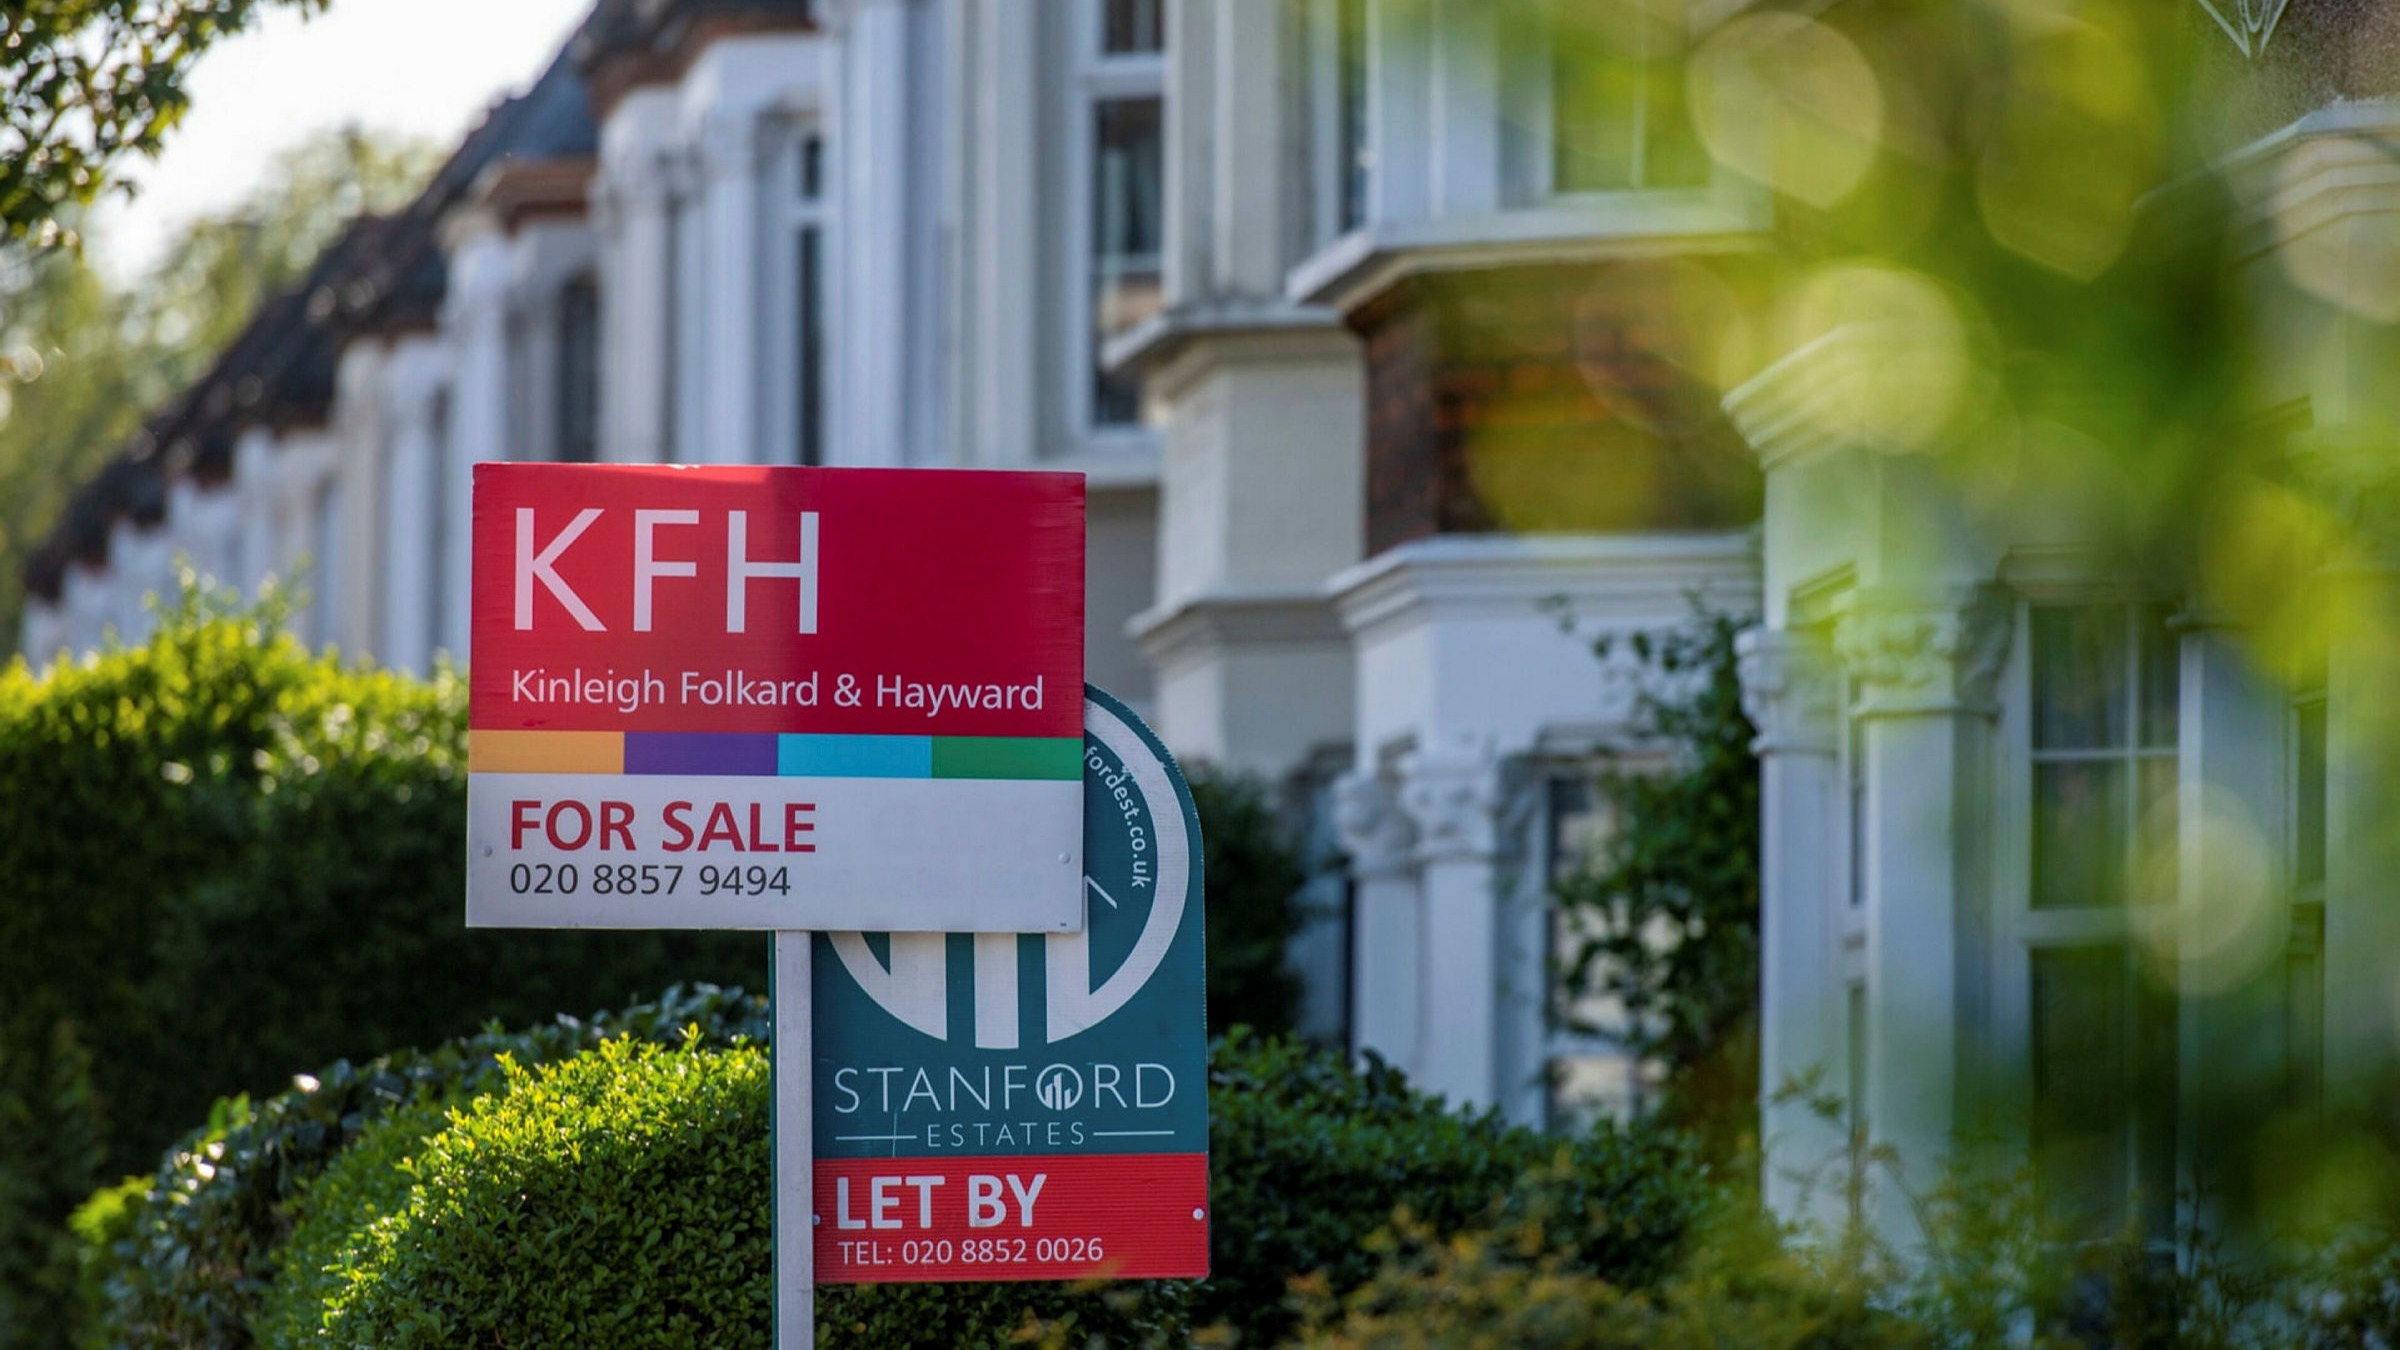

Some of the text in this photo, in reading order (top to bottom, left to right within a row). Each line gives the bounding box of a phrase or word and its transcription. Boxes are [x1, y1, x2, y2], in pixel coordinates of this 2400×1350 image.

[514, 507, 819, 634] KFH
[512, 669, 1043, 717] Kinleigh Folkard & Hayward
[511, 800, 816, 853] FOR SALE
[1084, 746, 1151, 888] fordest.co.uk
[510, 864, 792, 896] 020 8857 9494
[834, 1063, 1175, 1113] STANFORD
[927, 1122, 1084, 1147] ESTATES
[837, 1173, 1047, 1230] LET BY
[838, 1238, 1103, 1265] TEL: 020 8852 0026
